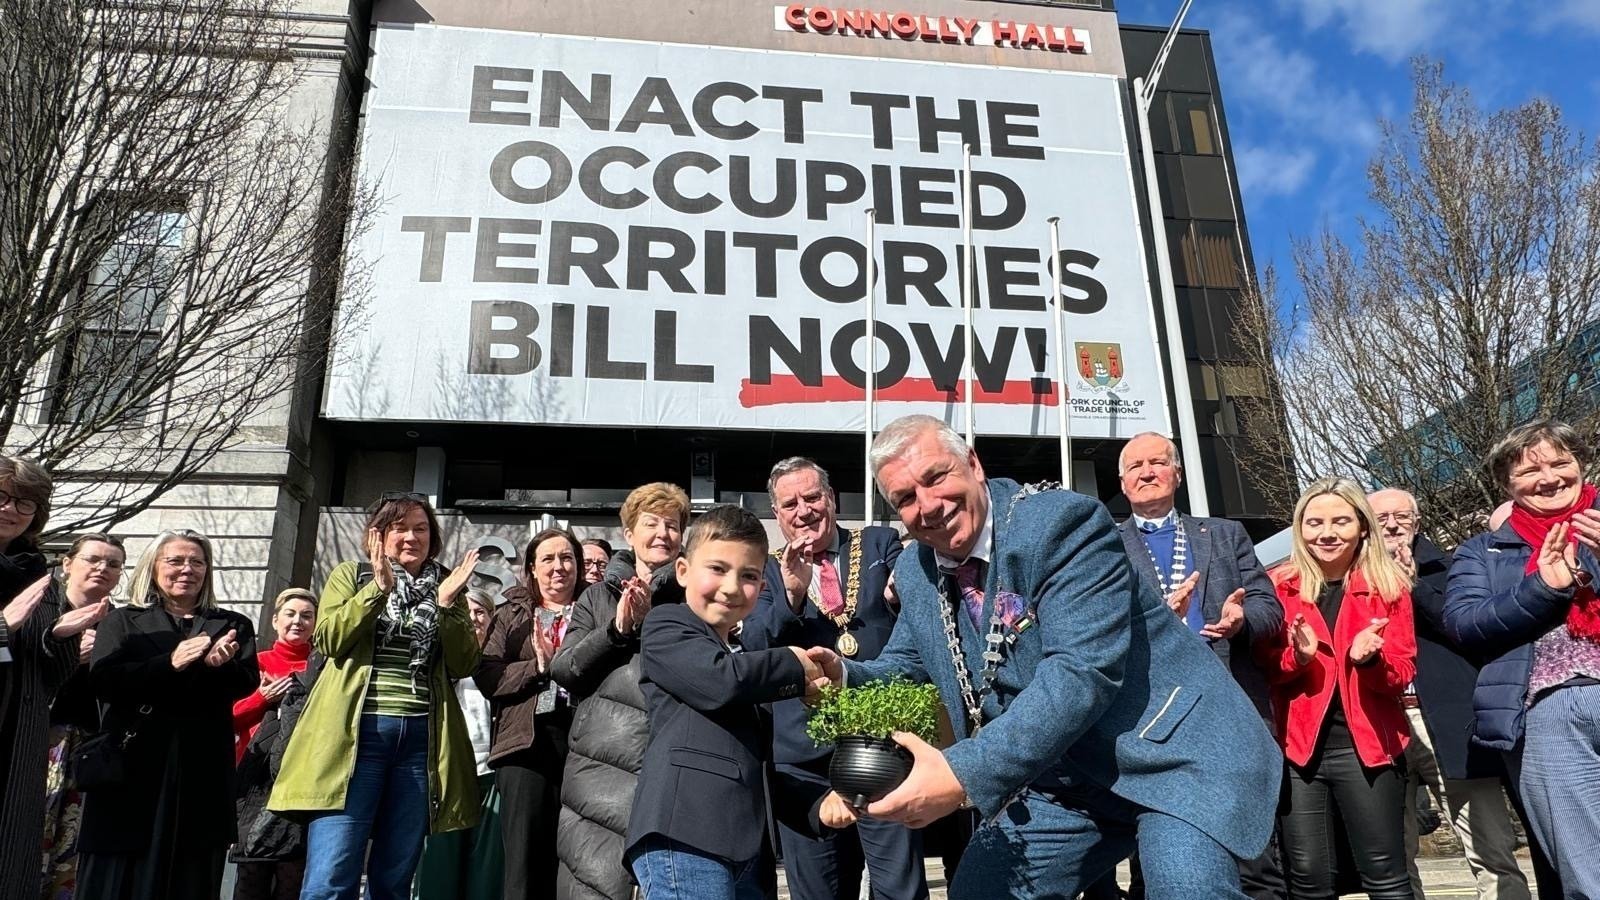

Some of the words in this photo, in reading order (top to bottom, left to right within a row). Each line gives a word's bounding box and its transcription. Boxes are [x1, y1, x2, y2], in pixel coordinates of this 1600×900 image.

[785, 4, 979, 44] CONNOLLY
[991, 20, 1085, 52] HALL
[469, 65, 823, 144] ENACT
[850, 91, 1046, 160] THE
[490, 140, 1027, 230] OCCUPIED
[401, 217, 1108, 314] TERRITORIES
[467, 301, 714, 383] BILL
[749, 315, 1053, 394] NOW!
[1073, 405, 1103, 413] TRADE
[1105, 406, 1140, 414] UNIONS
[1092, 399, 1131, 407] COUNCIL
